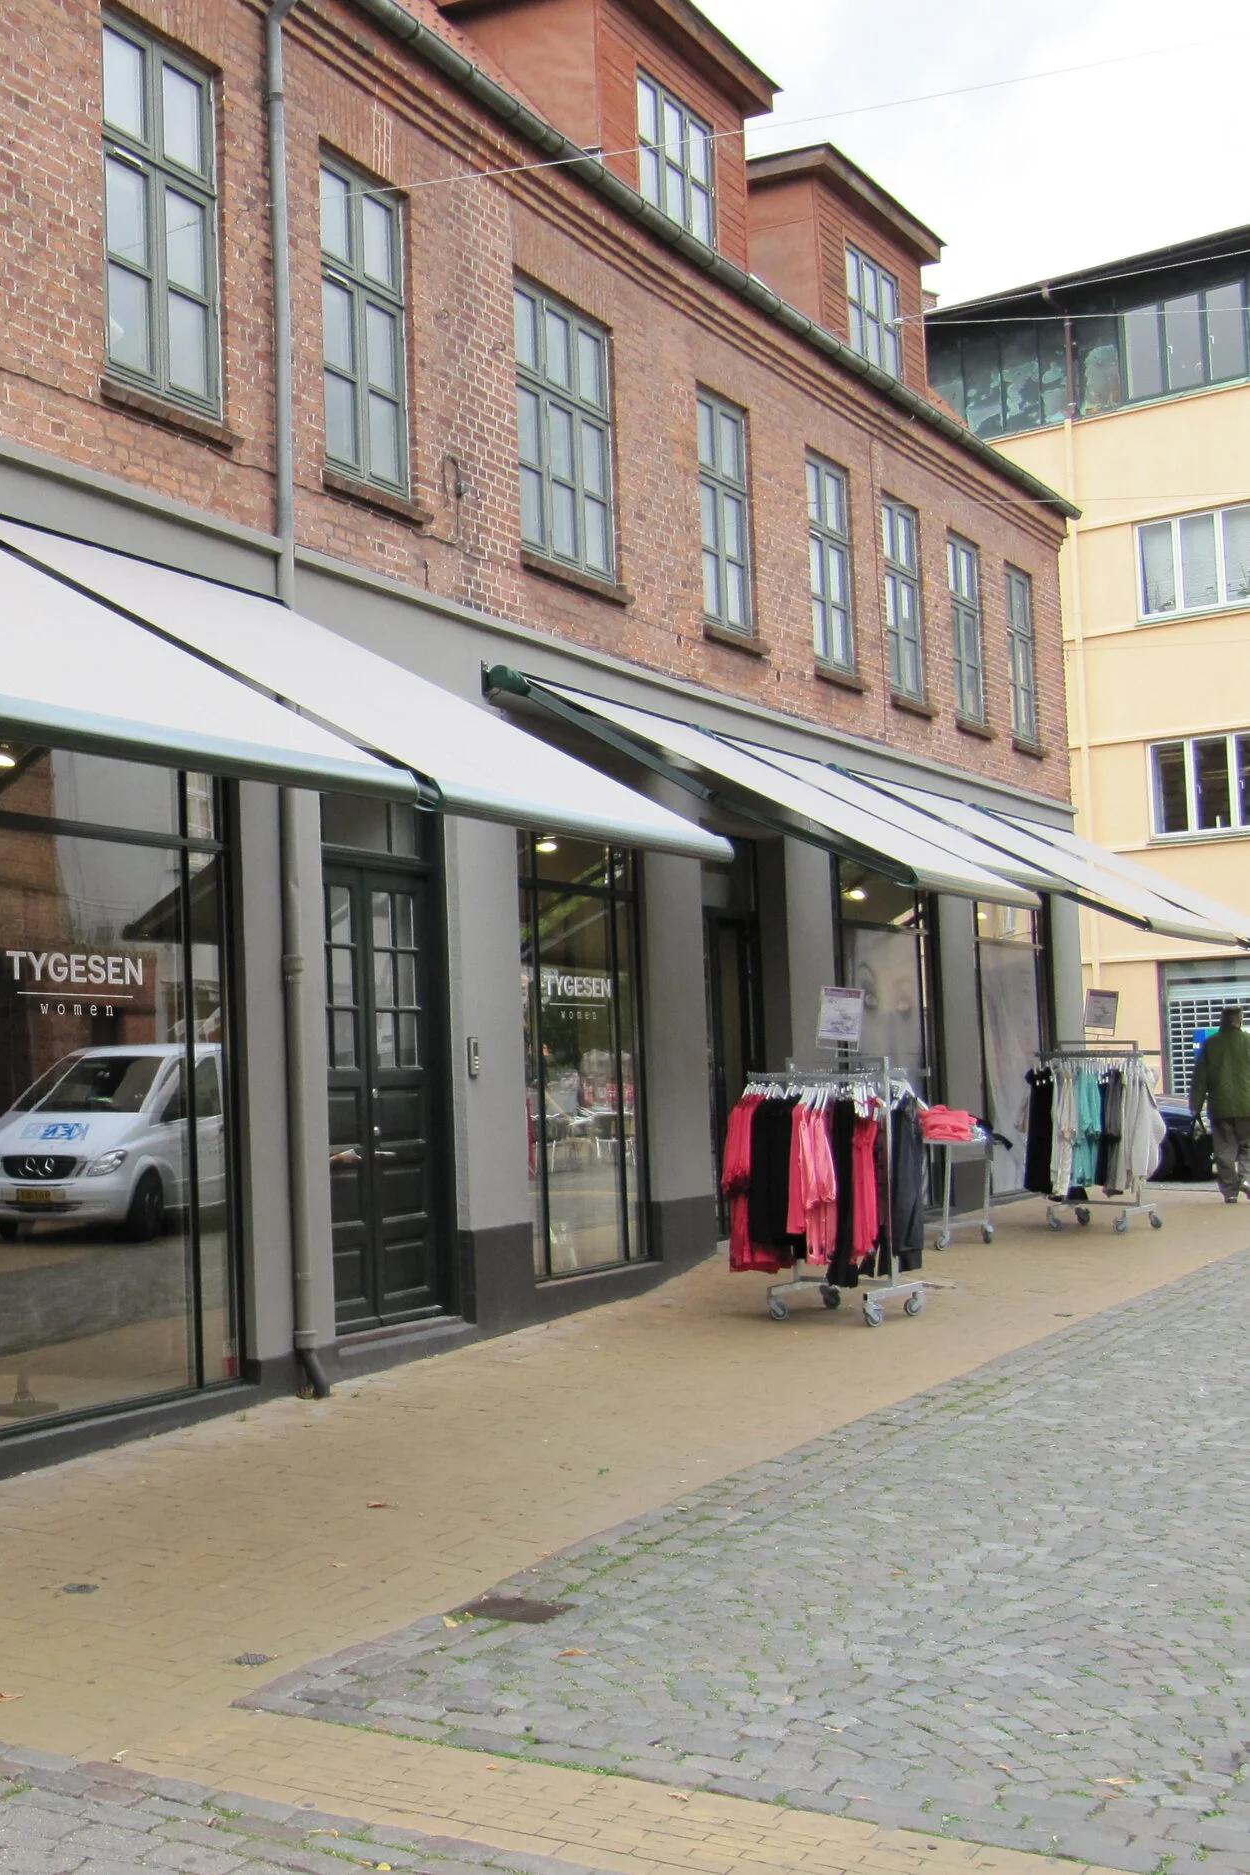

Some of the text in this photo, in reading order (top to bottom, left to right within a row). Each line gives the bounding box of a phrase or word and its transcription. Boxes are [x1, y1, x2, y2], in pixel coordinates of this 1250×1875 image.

[5, 950, 143, 985] TYGESEN
[544, 975, 612, 998] TYGESEN
[40, 1003, 114, 1017] women
[560, 1010, 597, 1020] women
